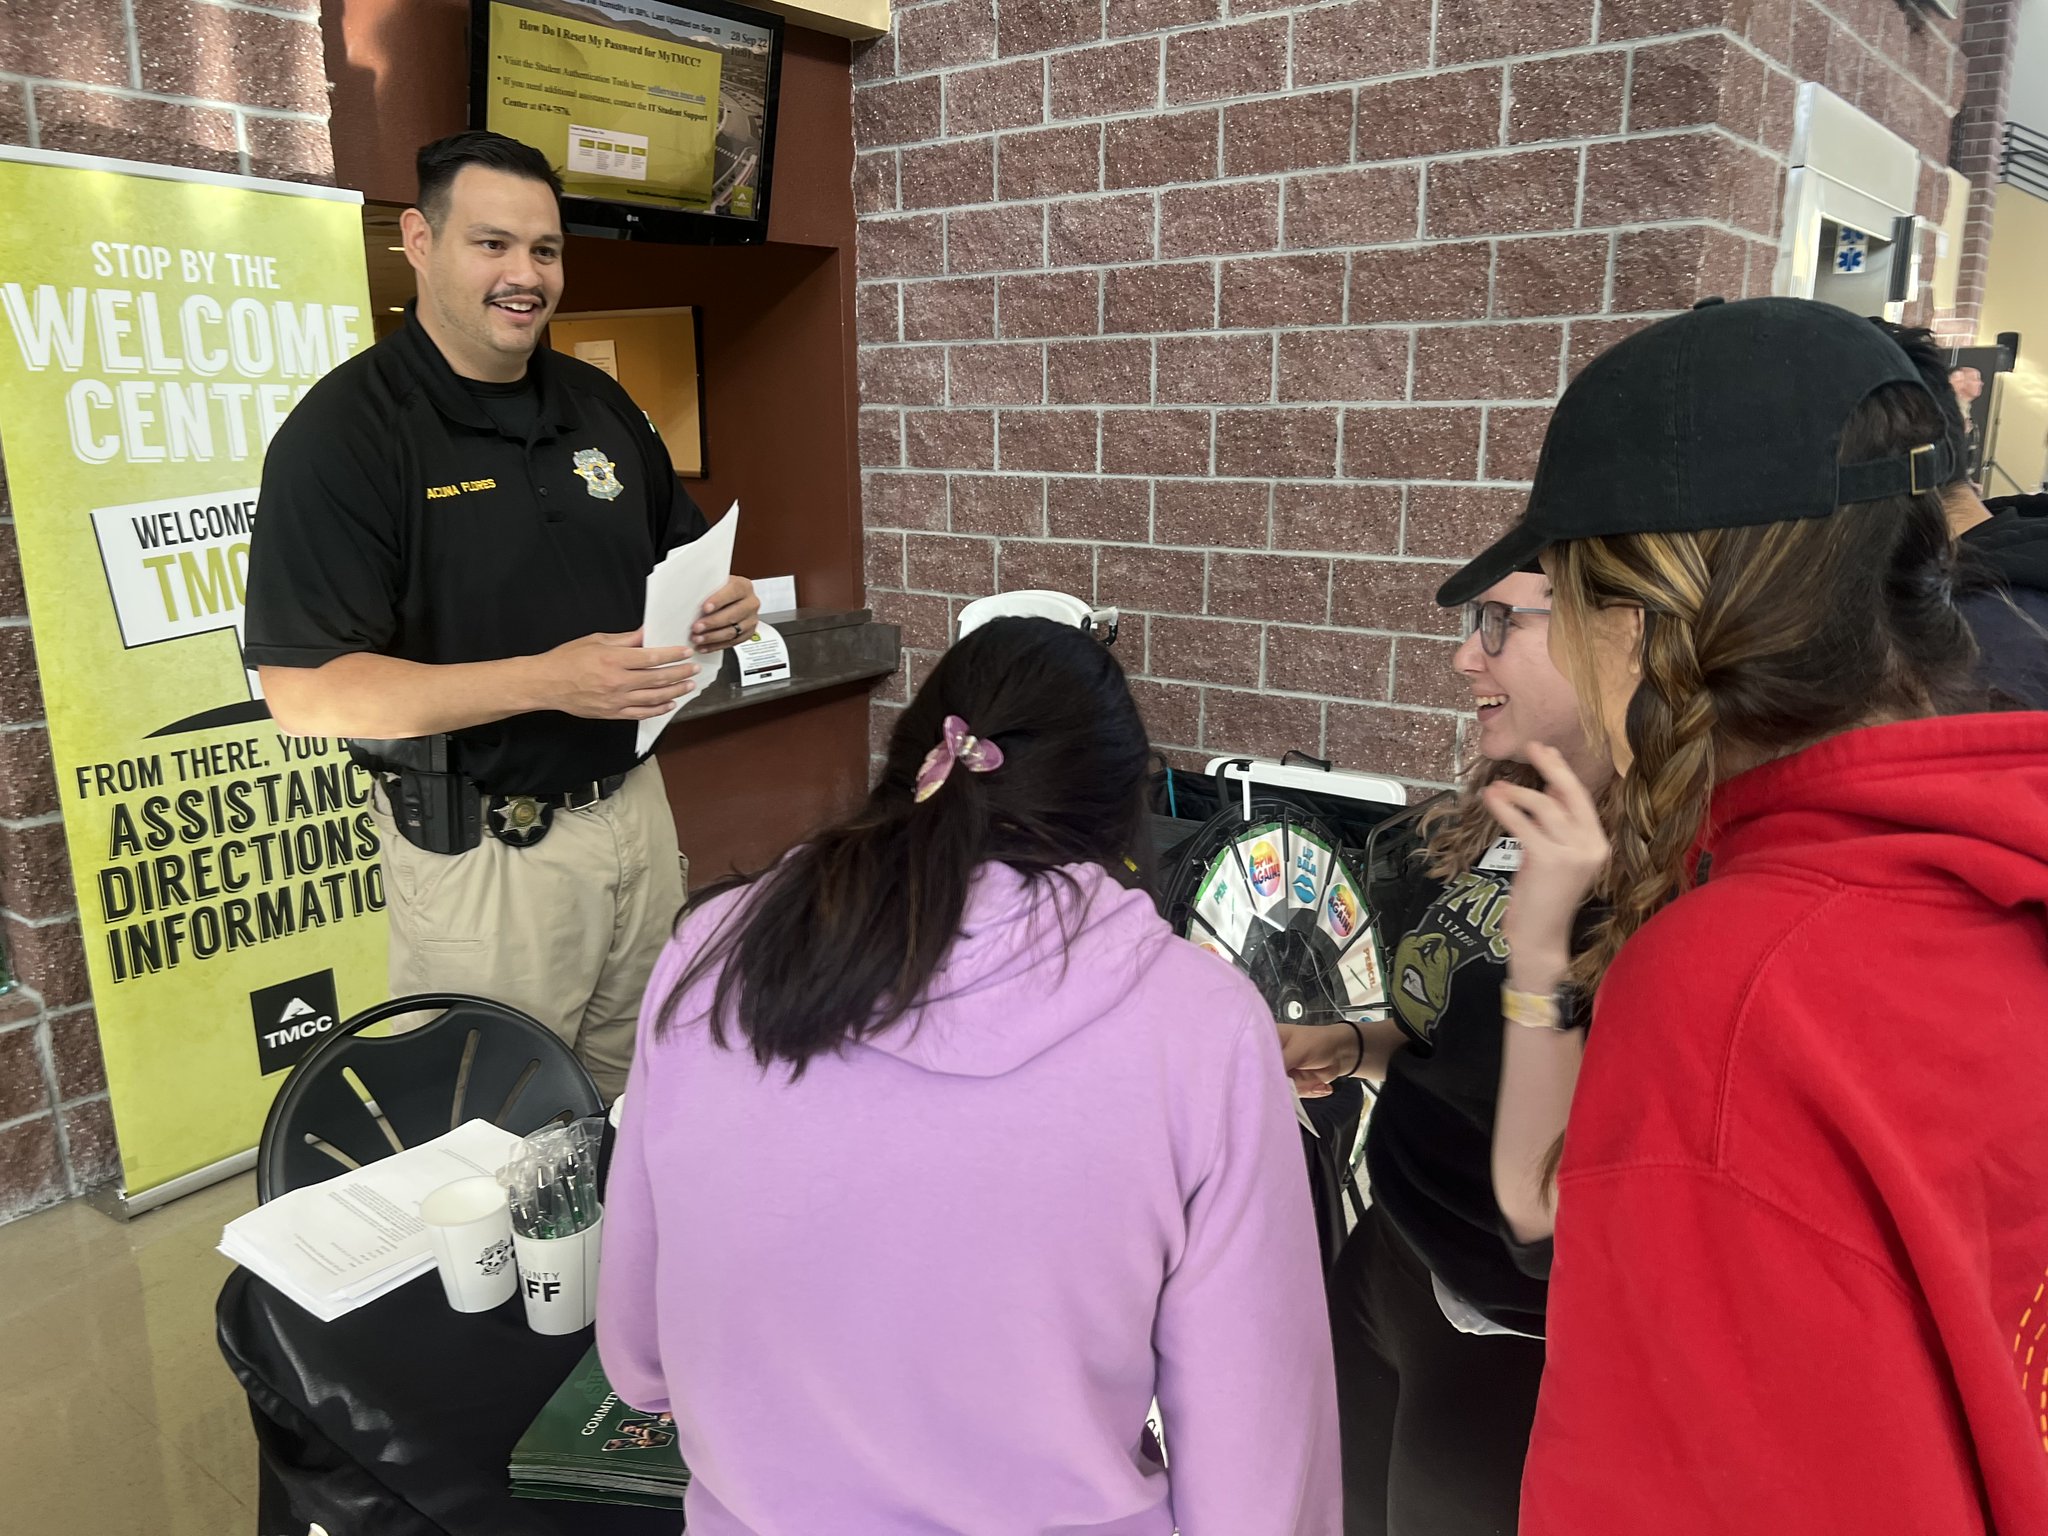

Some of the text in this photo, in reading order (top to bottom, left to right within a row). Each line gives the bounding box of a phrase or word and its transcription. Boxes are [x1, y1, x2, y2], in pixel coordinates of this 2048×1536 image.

[519, 19, 539, 32] How
[542, 24, 555, 36] Do
[563, 29, 586, 43] Reset
[588, 34, 602, 48] My
[604, 38, 642, 56] Password
[644, 47, 656, 57] for
[658, 49, 701, 67] MyTMCC?
[742, 33, 756, 47] Sep
[523, 58, 534, 69] the
[535, 61, 561, 74] Student
[648, 103, 656, 112] IT
[657, 105, 682, 117] Student
[683, 110, 707, 121] Support
[91, 240, 281, 290] STOP BY THE
[0, 282, 360, 378] WELCOME
[65, 379, 313, 465] CENTE
[131, 500, 257, 549] WELCOME
[142, 542, 252, 622] TMC
[76, 755, 164, 799] FROM
[109, 760, 370, 861] ASSISTANC
[97, 811, 382, 924] DIRECTIONS
[106, 863, 387, 984] INFORMATIO
[1363, 947, 1375, 989] PENCIL
[263, 1014, 334, 1050] TMCC
